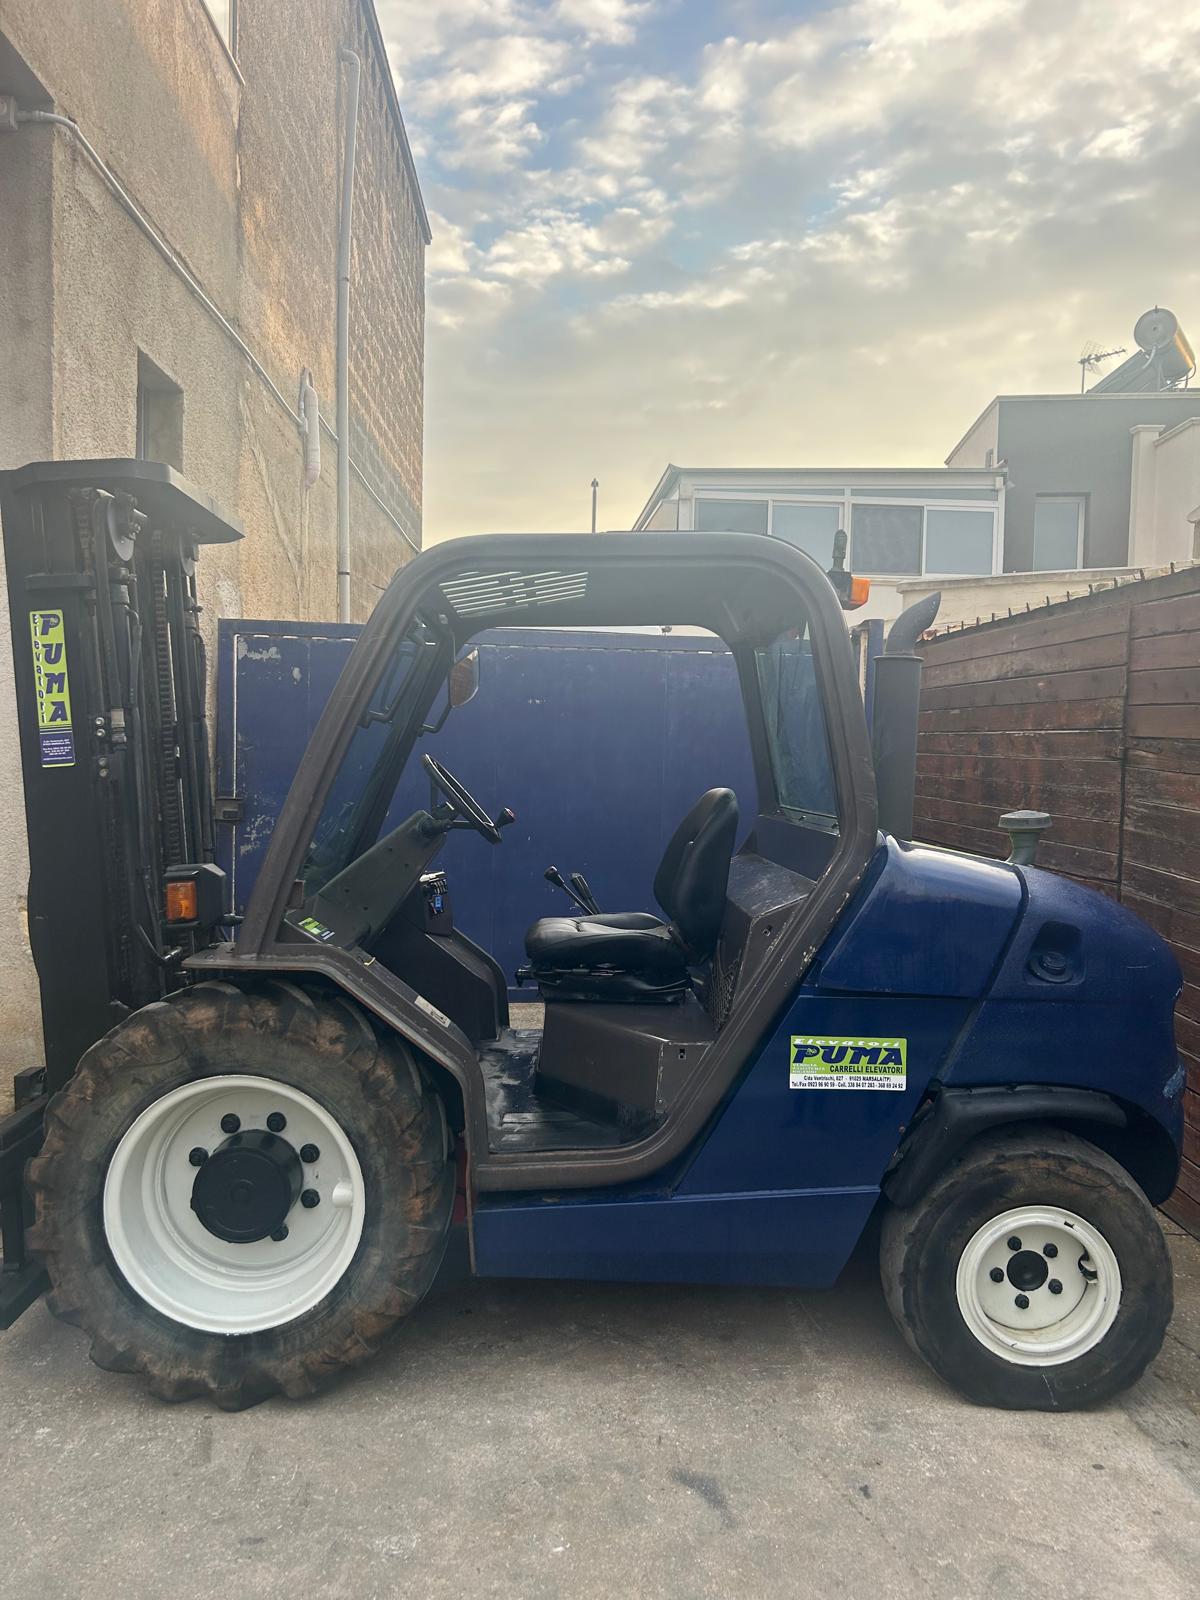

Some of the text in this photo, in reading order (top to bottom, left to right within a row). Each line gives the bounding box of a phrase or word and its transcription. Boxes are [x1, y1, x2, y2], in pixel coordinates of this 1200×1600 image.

[40, 613, 69, 723] PUMA
[793, 1038, 901, 1047] Elevatori
[792, 1044, 902, 1065] PUMA
[829, 1065, 903, 1074] CARRELLI ELEVATORI
